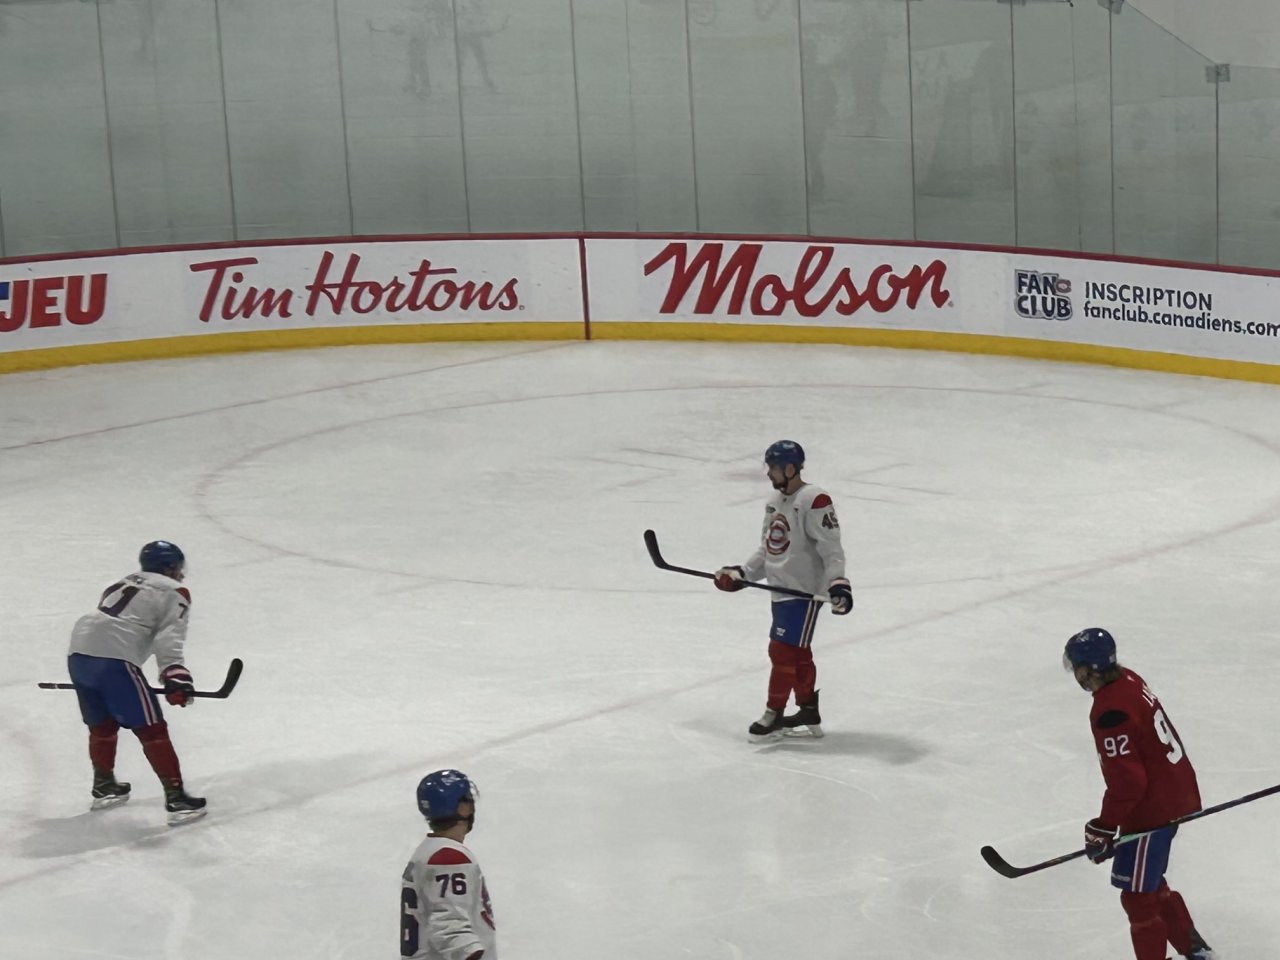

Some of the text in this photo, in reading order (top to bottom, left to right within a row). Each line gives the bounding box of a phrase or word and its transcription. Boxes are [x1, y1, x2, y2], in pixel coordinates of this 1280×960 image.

[190, 250, 521, 322] Tim Hortons
[644, 243, 950, 317] Molson
[1017, 273, 1057, 295] FAN
[1085, 281, 1212, 311] INSCRIPTION
[1104, 734, 1131, 758] 92
[436, 873, 468, 898] 76
